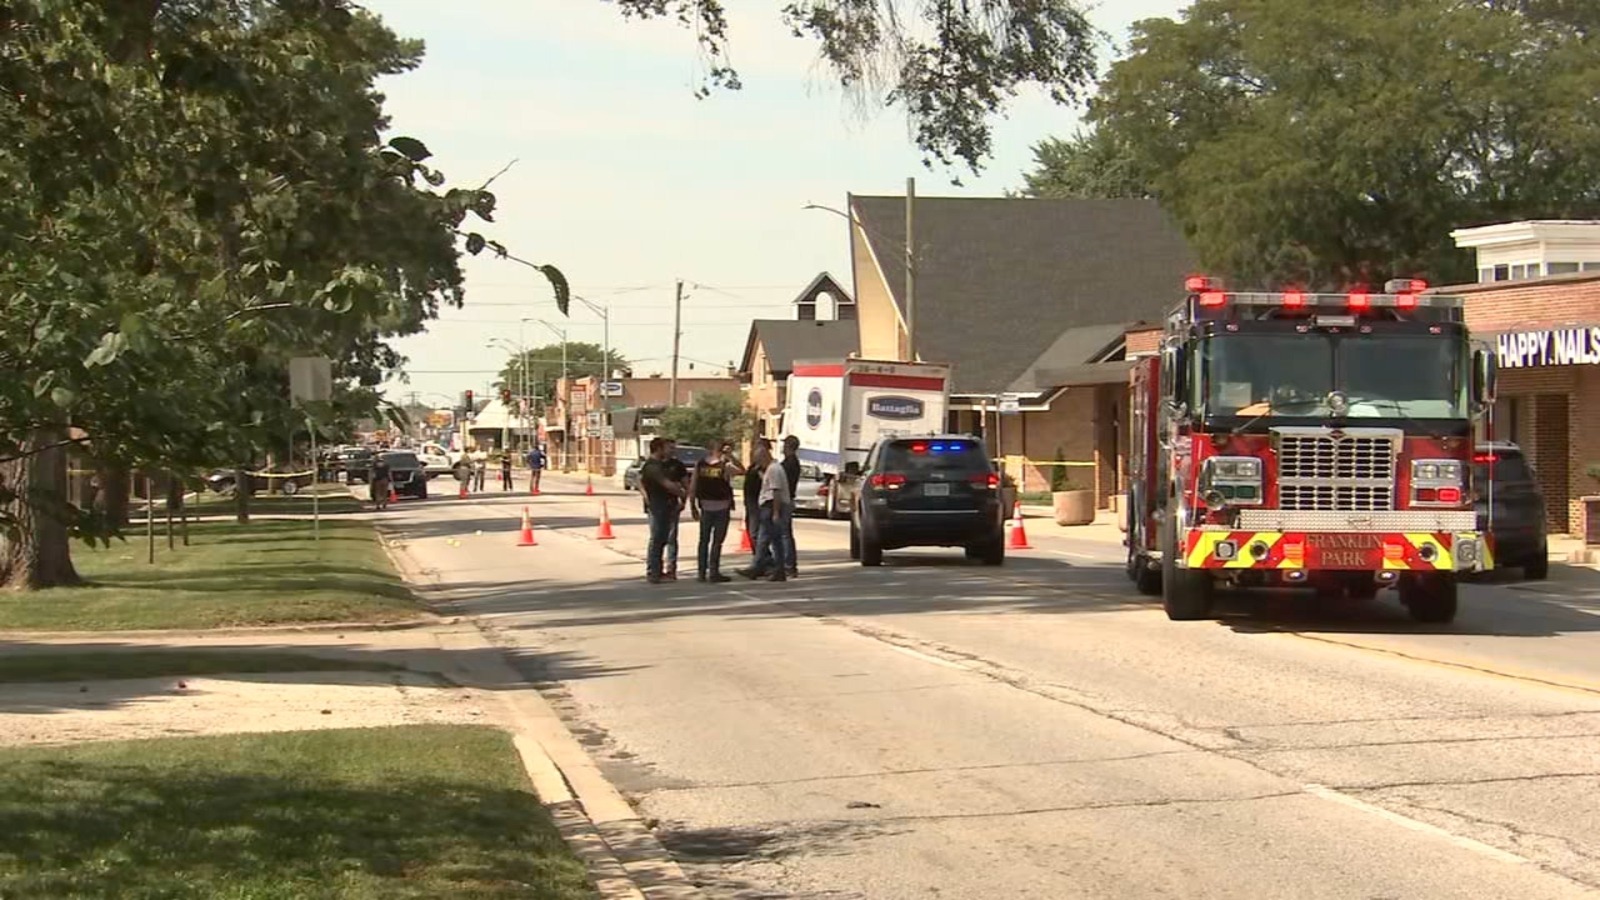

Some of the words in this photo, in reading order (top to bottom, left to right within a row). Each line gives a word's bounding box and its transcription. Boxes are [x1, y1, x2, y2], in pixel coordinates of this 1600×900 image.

[1496, 330, 1549, 368] HAPPY
[1554, 327, 1600, 365] NAILS
[872, 402, 920, 415] Battaglia
[1305, 534, 1382, 549] FRANKLIN
[1321, 551, 1366, 566] PARK
